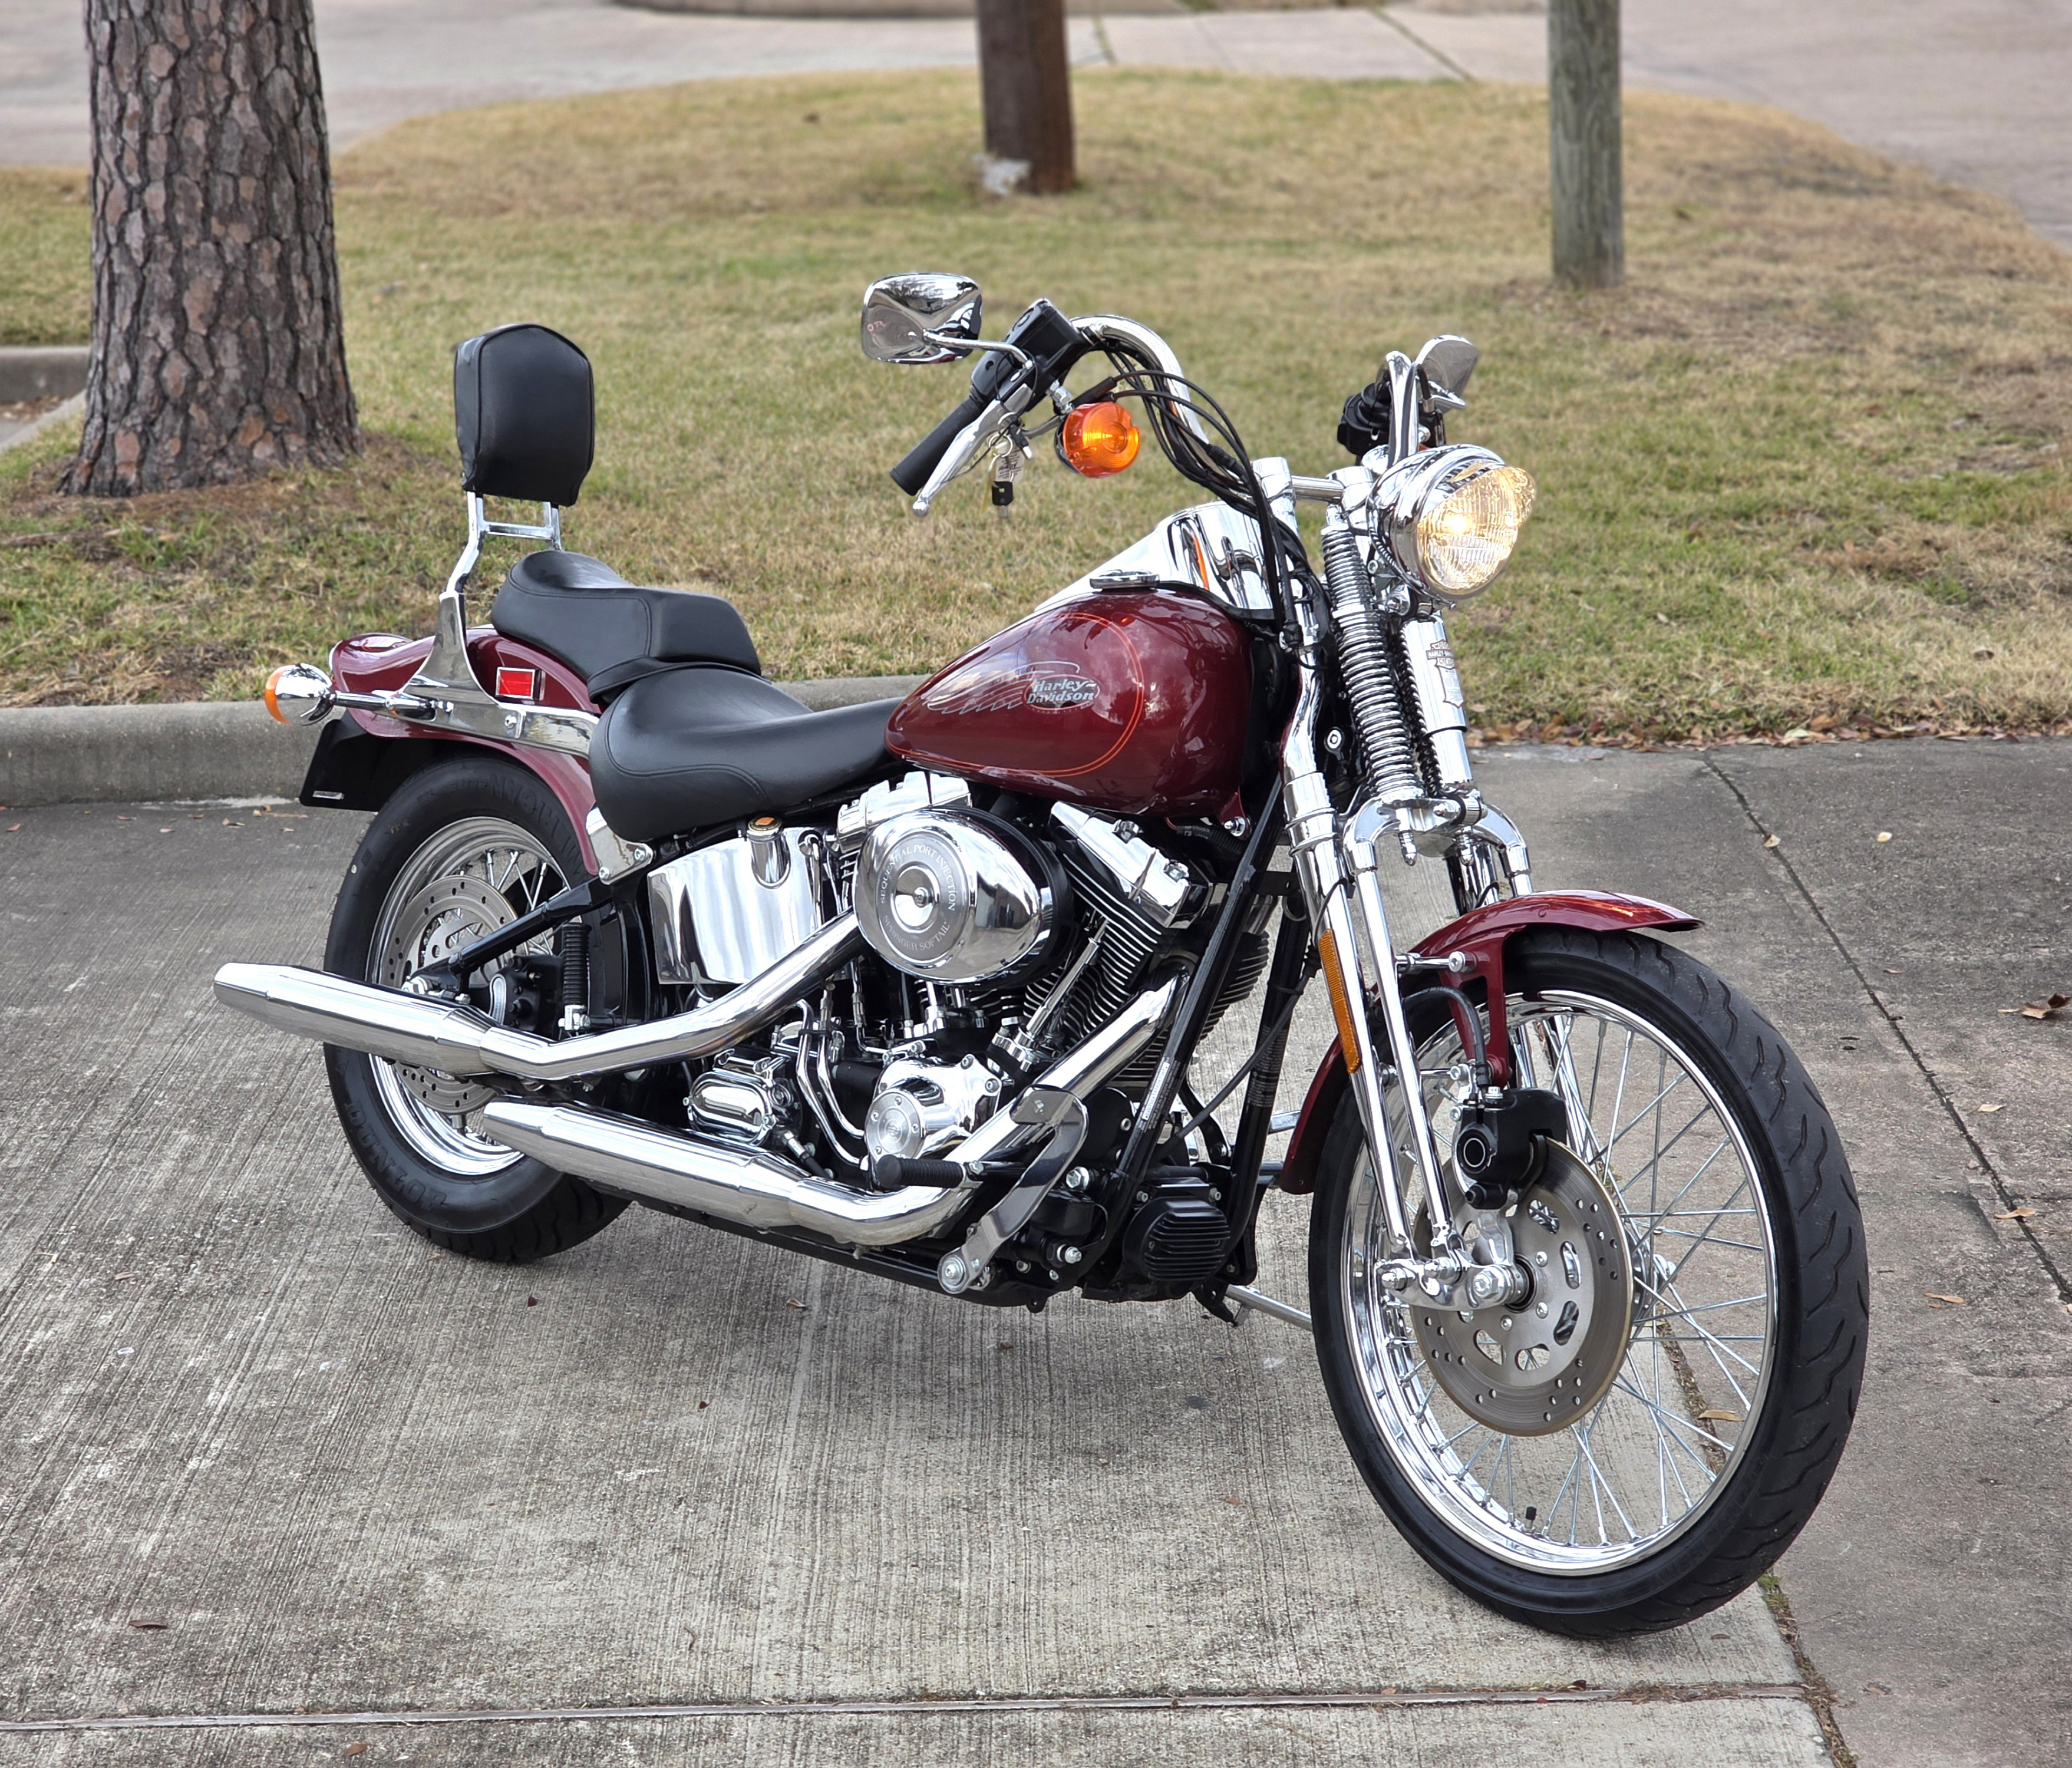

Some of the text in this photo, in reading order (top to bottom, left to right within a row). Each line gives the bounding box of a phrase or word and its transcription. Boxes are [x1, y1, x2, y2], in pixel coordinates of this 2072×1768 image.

[1027, 690, 1095, 704] Davidson
[1033, 678, 1097, 692] Harley-
[880, 844, 956, 911] SEQUENTIAL PORT INJECTION
[344, 1100, 450, 1212] DUNLOP
